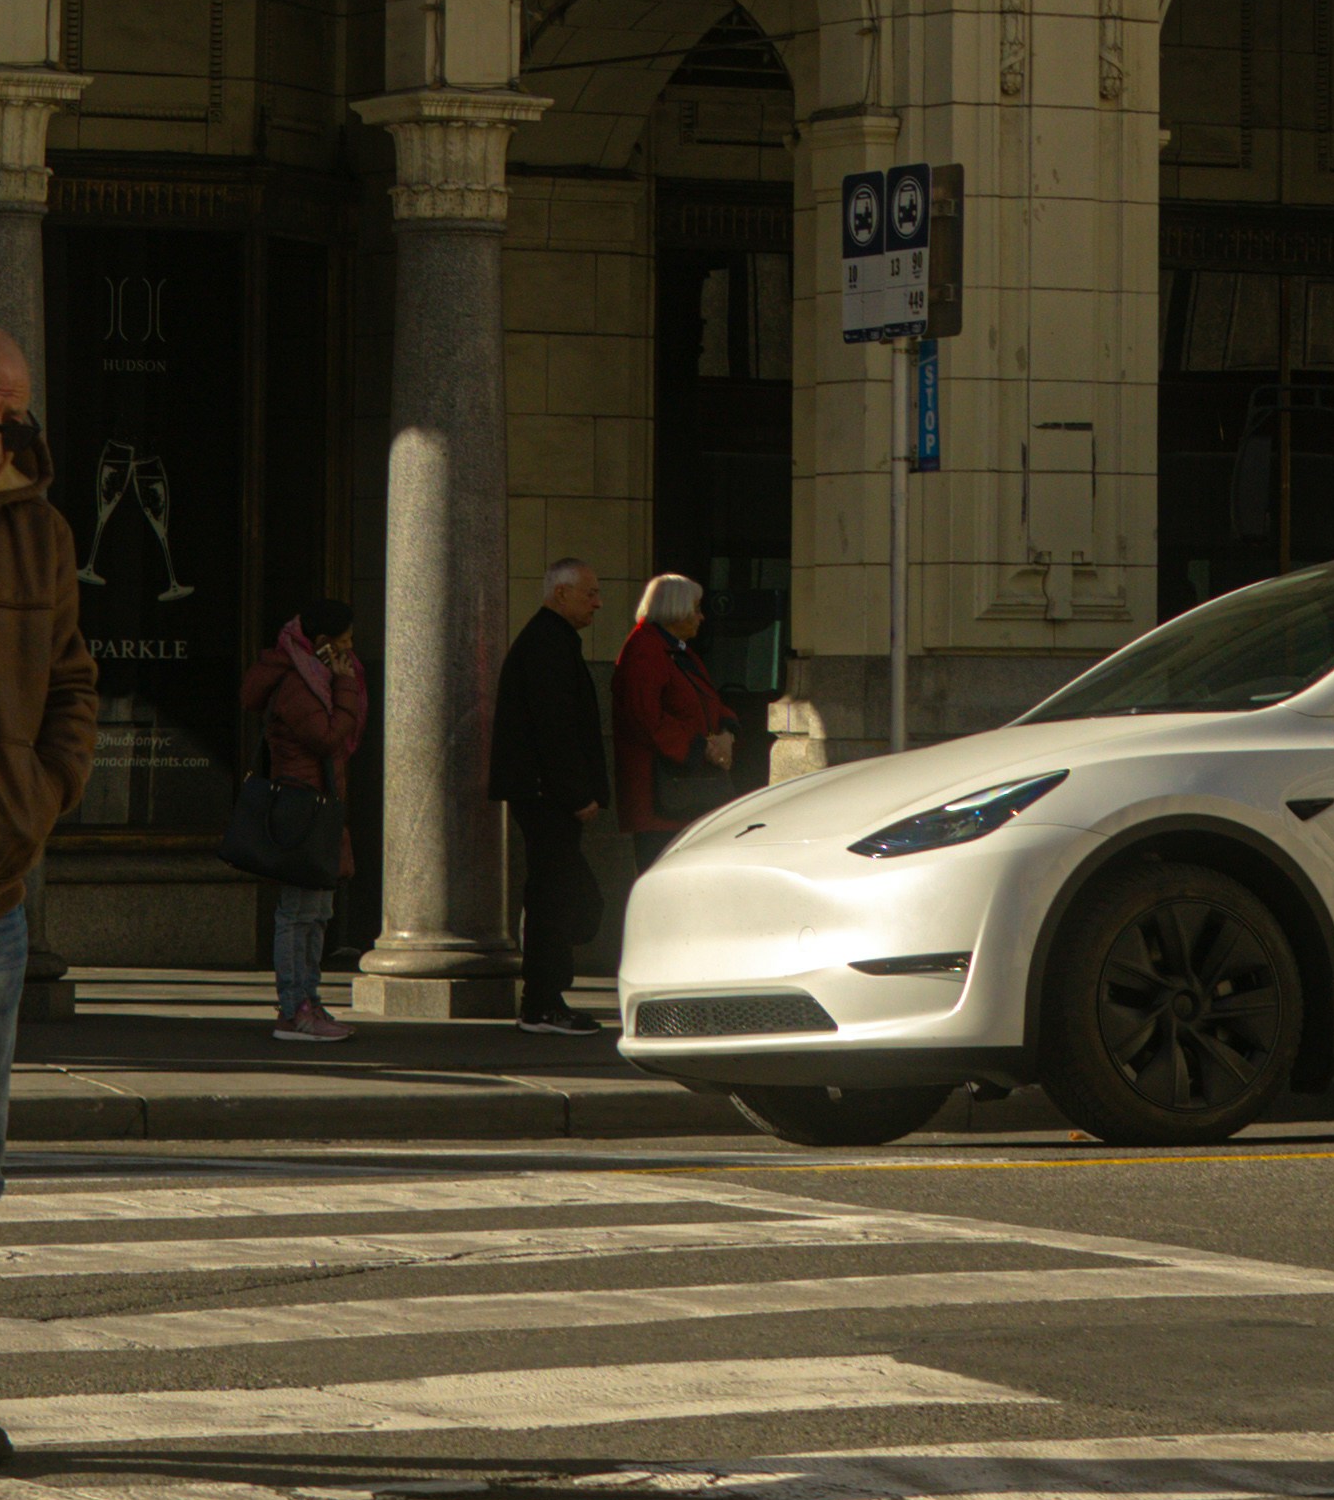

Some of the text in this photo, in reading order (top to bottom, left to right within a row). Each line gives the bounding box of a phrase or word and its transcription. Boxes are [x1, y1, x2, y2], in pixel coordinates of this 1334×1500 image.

[890, 257, 901, 277] 13
[912, 250, 924, 270] 90
[848, 264, 858, 284] 10
[908, 290, 924, 310] 449
[102, 358, 167, 372] HUDSON
[924, 364, 936, 455] STOP
[88, 639, 188, 660] PARKLE
